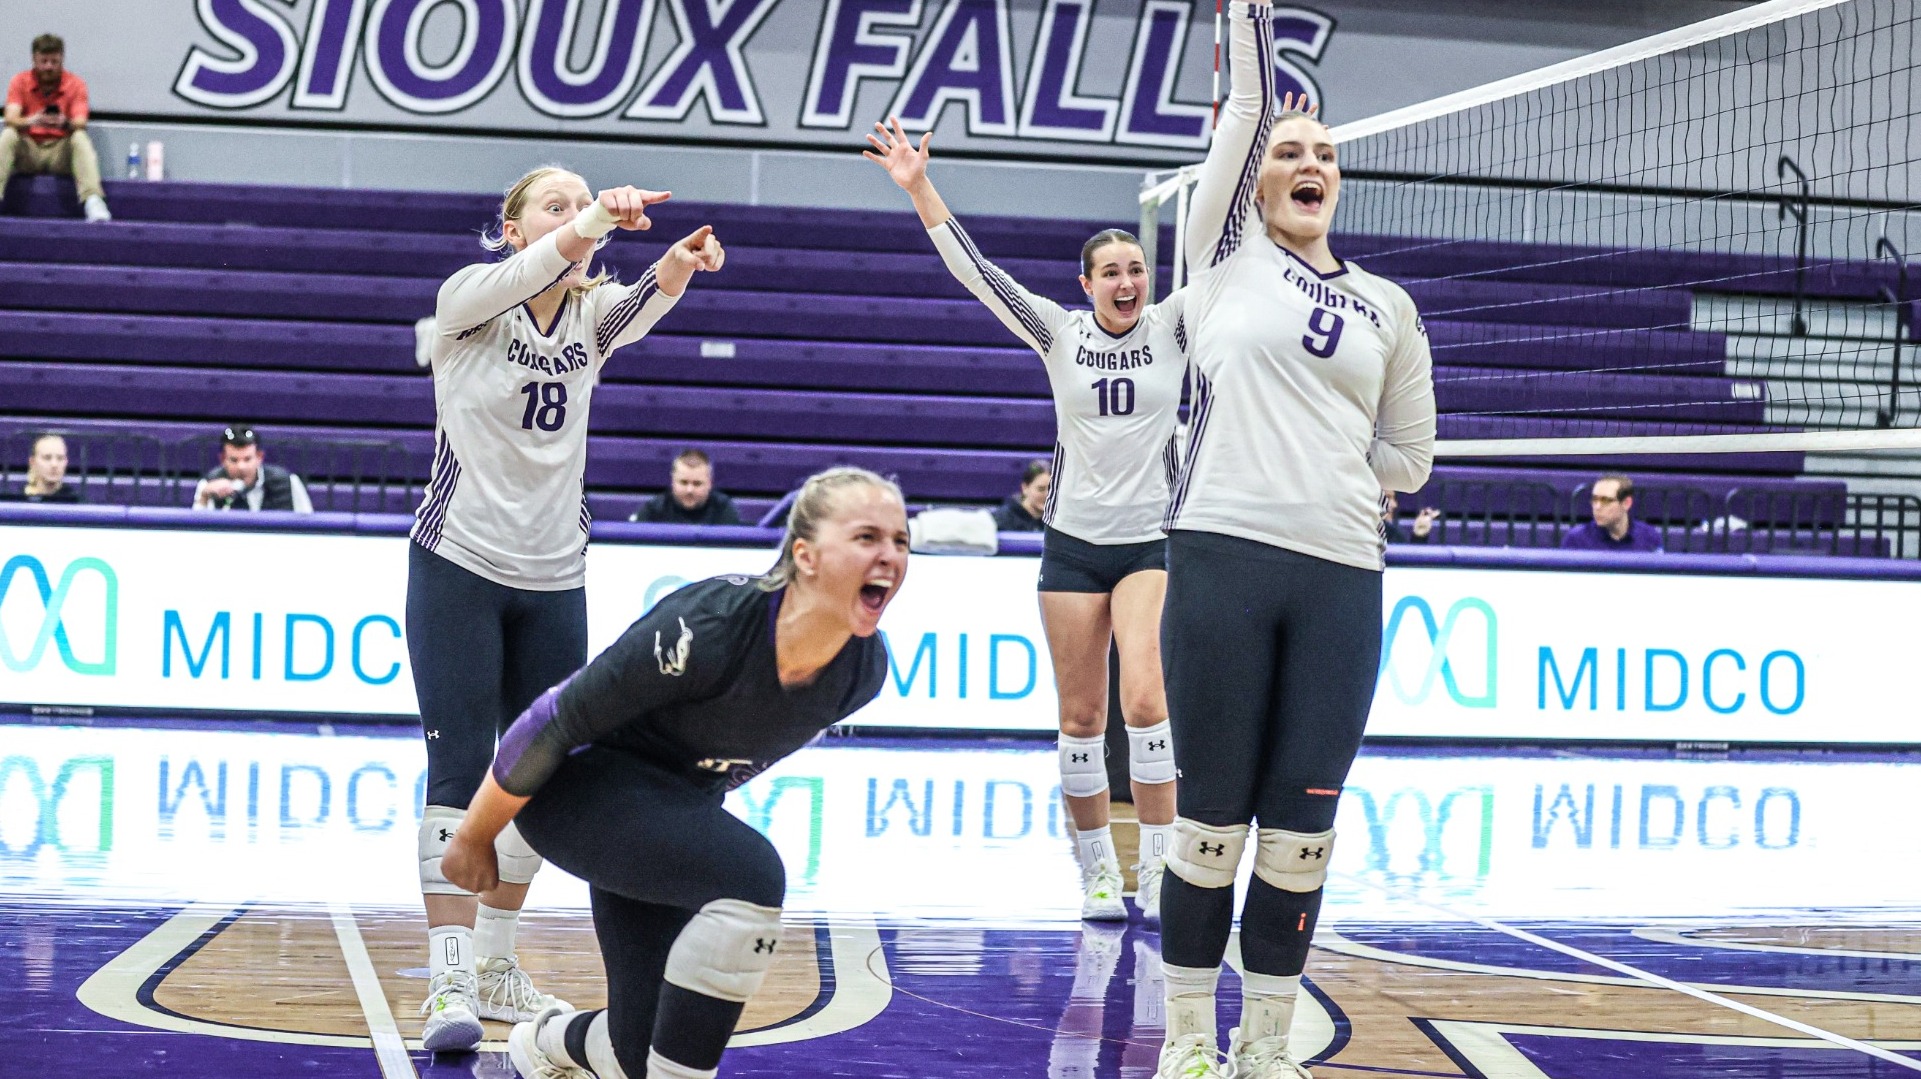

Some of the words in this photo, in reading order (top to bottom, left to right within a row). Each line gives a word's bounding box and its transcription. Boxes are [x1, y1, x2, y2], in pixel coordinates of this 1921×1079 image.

[172, 0, 777, 127] SIOUX
[507, 338, 588, 376] COUGARS
[1075, 344, 1153, 371] COUGARS
[1302, 307, 1345, 359] 9
[521, 381, 568, 432] 18
[1091, 377, 1135, 417] 10
[162, 609, 402, 686] MIDC
[878, 631, 1058, 701] MID
[1538, 646, 1805, 715] MIDCO
